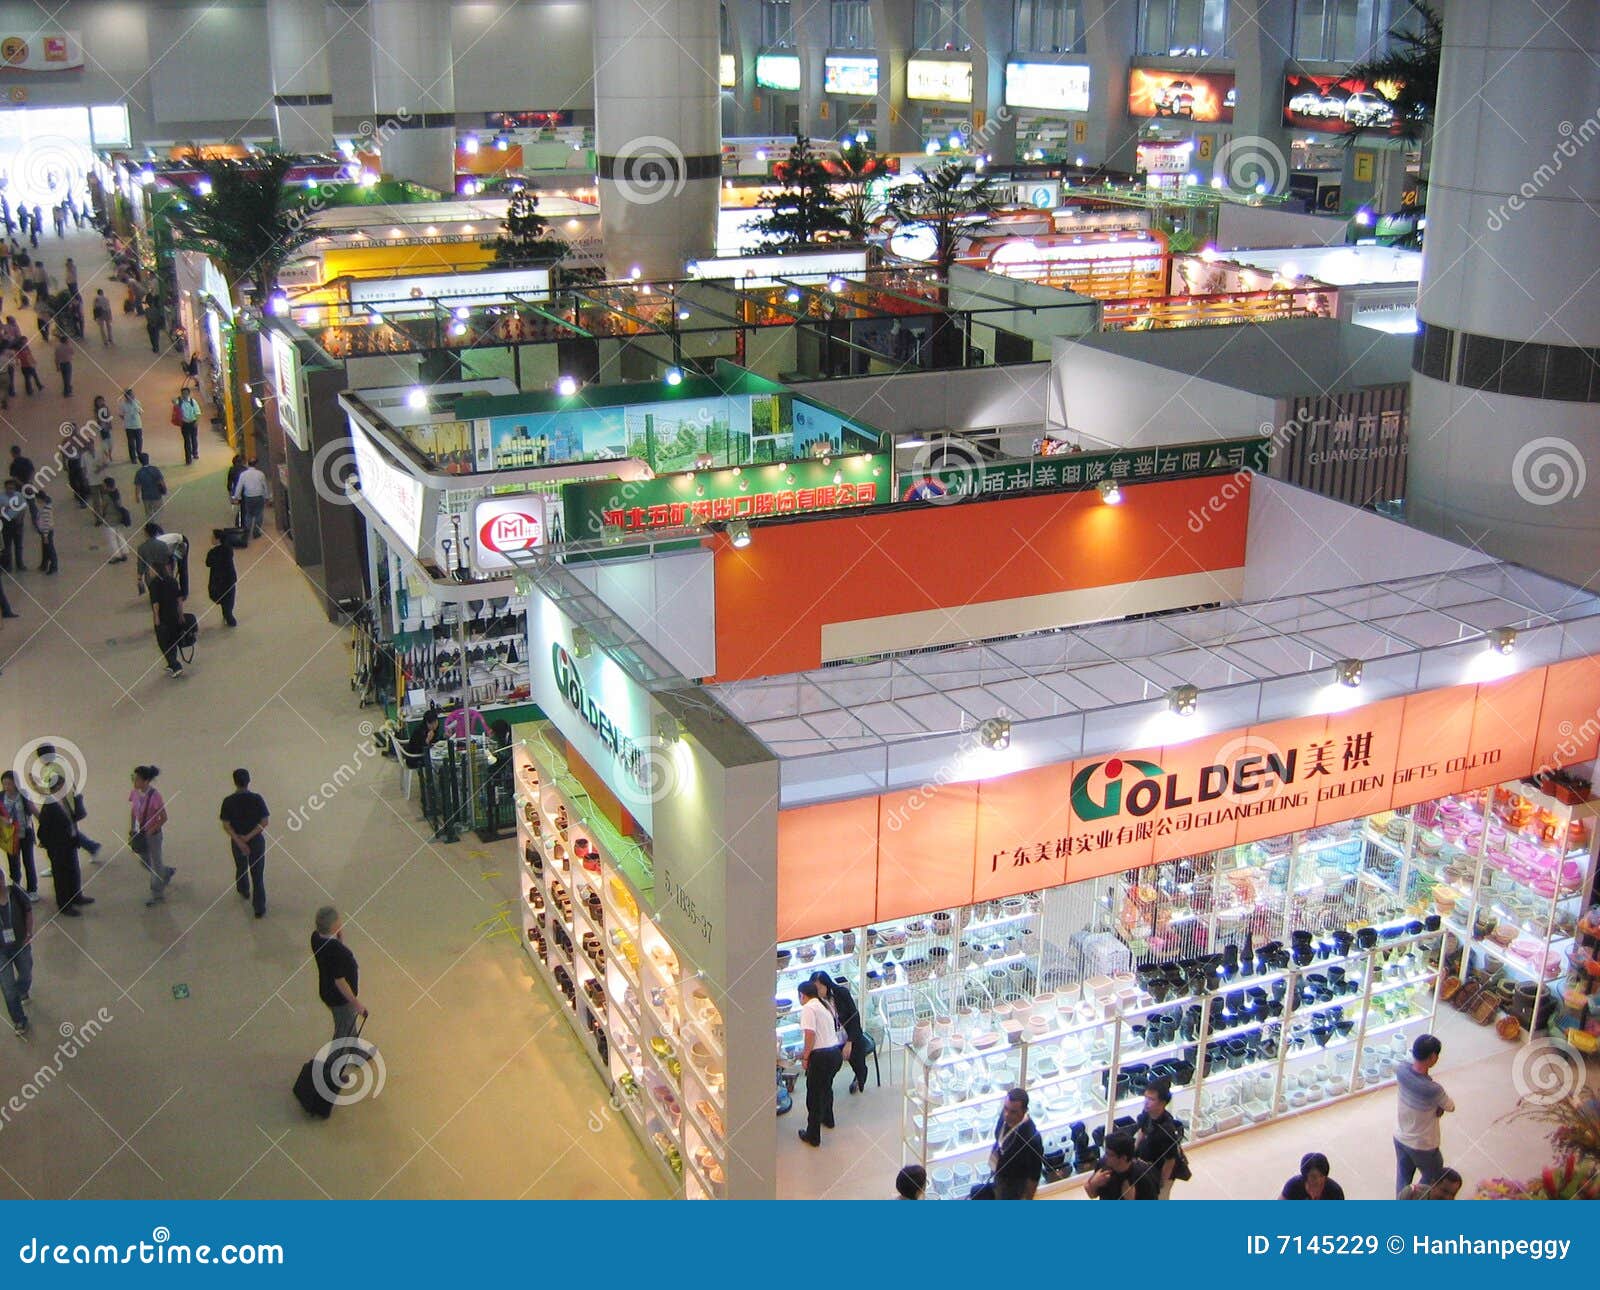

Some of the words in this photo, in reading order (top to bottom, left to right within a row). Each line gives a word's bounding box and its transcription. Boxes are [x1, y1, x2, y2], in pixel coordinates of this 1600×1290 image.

[1201, 140, 1209, 157] G
[1357, 158, 1368, 176] F
[1308, 443, 1398, 465] GUANGZHOU
[552, 642, 618, 754] GOLDEN
[1070, 748, 1298, 822] GOLDEN
[1303, 731, 1374, 780] 美祺
[991, 812, 1194, 873] 广东美祺实业有限公司
[1317, 773, 1385, 802] GOLDEN
[1393, 761, 1438, 785] GIFTS
